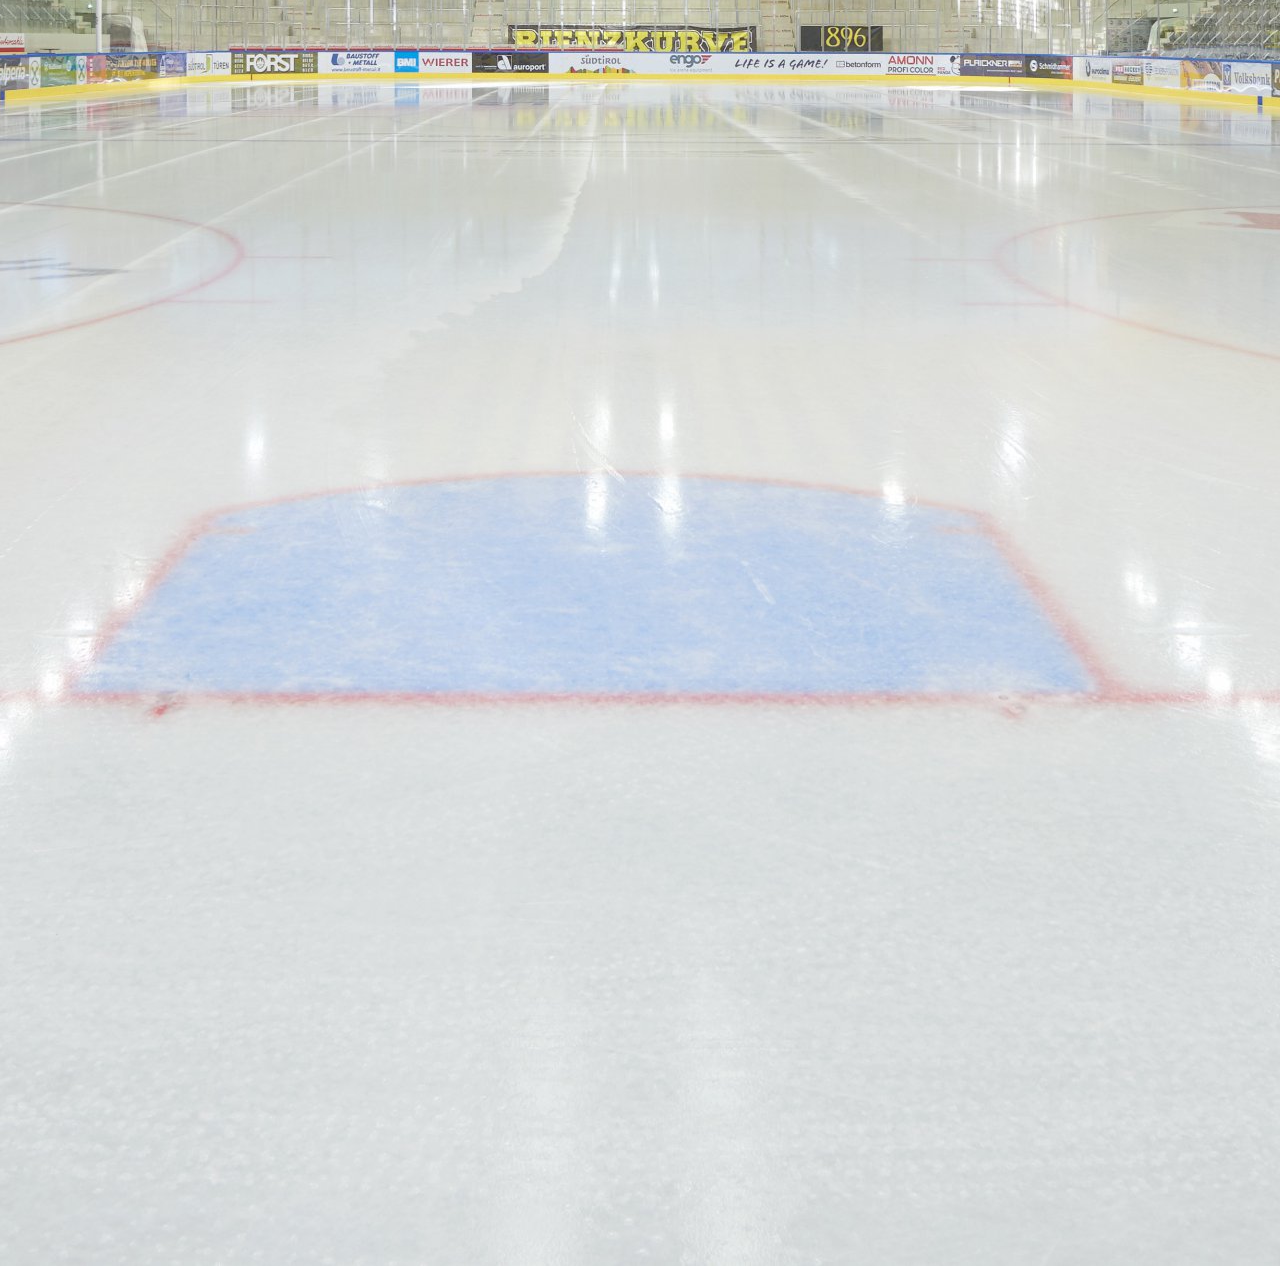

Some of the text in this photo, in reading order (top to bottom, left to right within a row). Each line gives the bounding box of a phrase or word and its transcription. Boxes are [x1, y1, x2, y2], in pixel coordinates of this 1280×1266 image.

[821, 27, 867, 48] 896
[246, 53, 298, 72] FORST
[397, 58, 416, 67] BMI
[422, 58, 469, 67] WIERER
[670, 55, 701, 68] engo
[735, 59, 759, 68] LIFE
[778, 59, 785, 67] A
[789, 59, 828, 69] GAME!
[888, 56, 933, 65] AMONN
[513, 64, 545, 72] auroport
